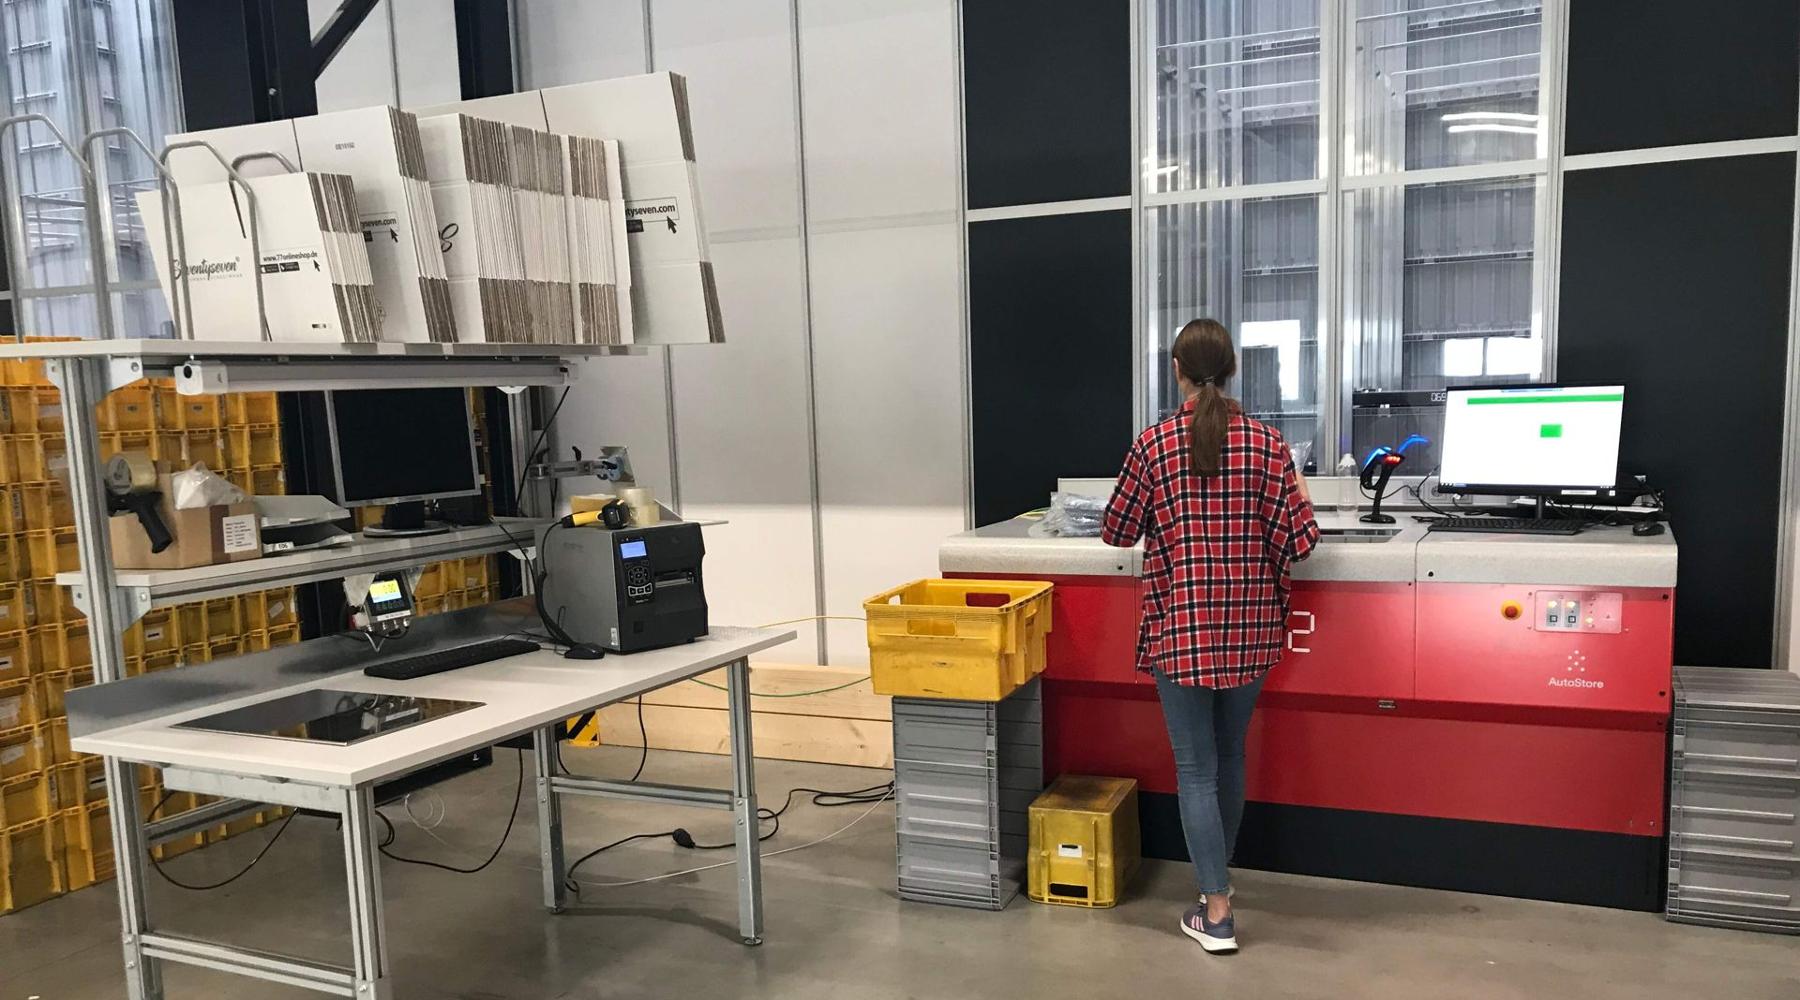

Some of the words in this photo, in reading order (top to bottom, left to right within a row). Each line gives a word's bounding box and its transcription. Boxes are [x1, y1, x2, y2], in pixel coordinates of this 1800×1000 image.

[173, 258, 237, 281] Sventyseven
[1287, 610, 1316, 653] 2
[1548, 677, 1605, 689] AutoStore
